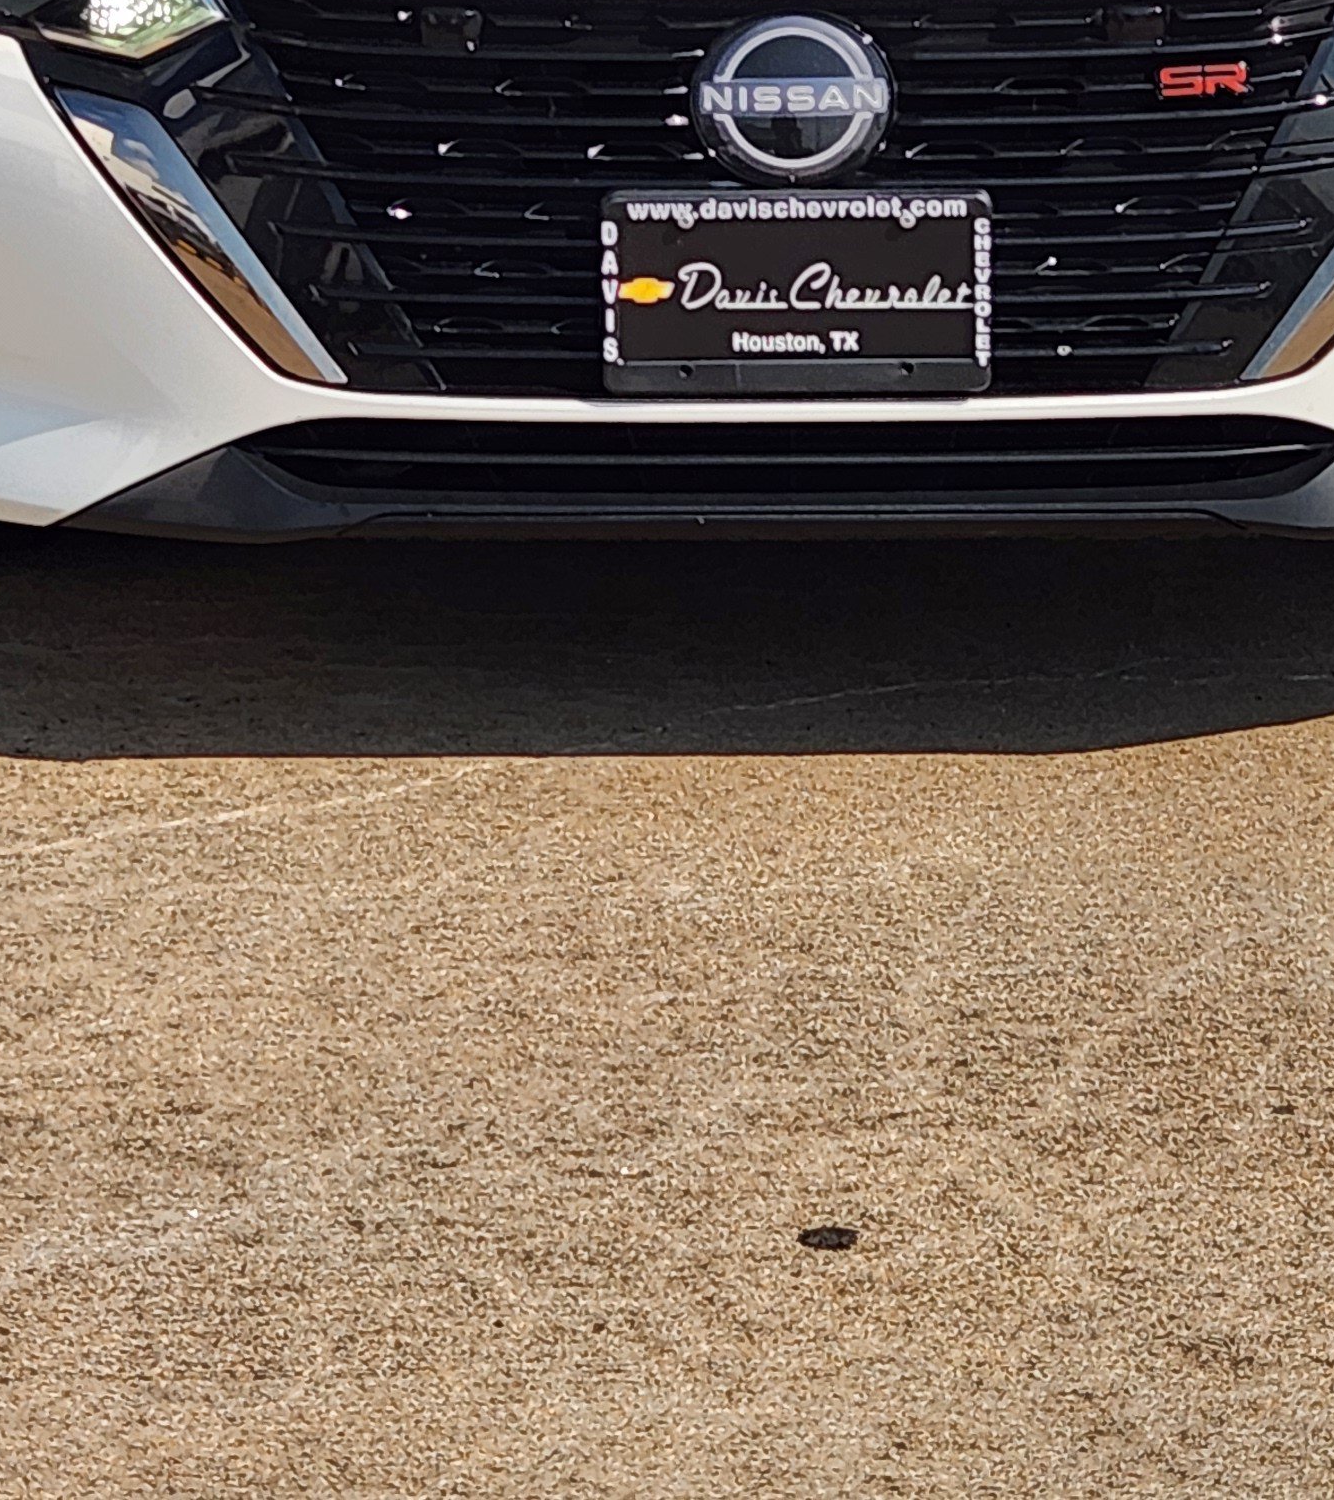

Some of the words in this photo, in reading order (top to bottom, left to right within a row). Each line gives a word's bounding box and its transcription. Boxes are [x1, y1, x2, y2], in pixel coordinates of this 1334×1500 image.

[1159, 61, 1249, 98] SR
[702, 84, 885, 113] NISSAN
[625, 195, 968, 221] www.davischevrolet.com
[599, 219, 620, 363] DAVIS
[677, 260, 789, 311] Davis
[789, 260, 975, 311] Chevrolet
[972, 217, 993, 368] CHEVROLET
[730, 330, 827, 354] Houston,
[829, 330, 861, 353] TX
